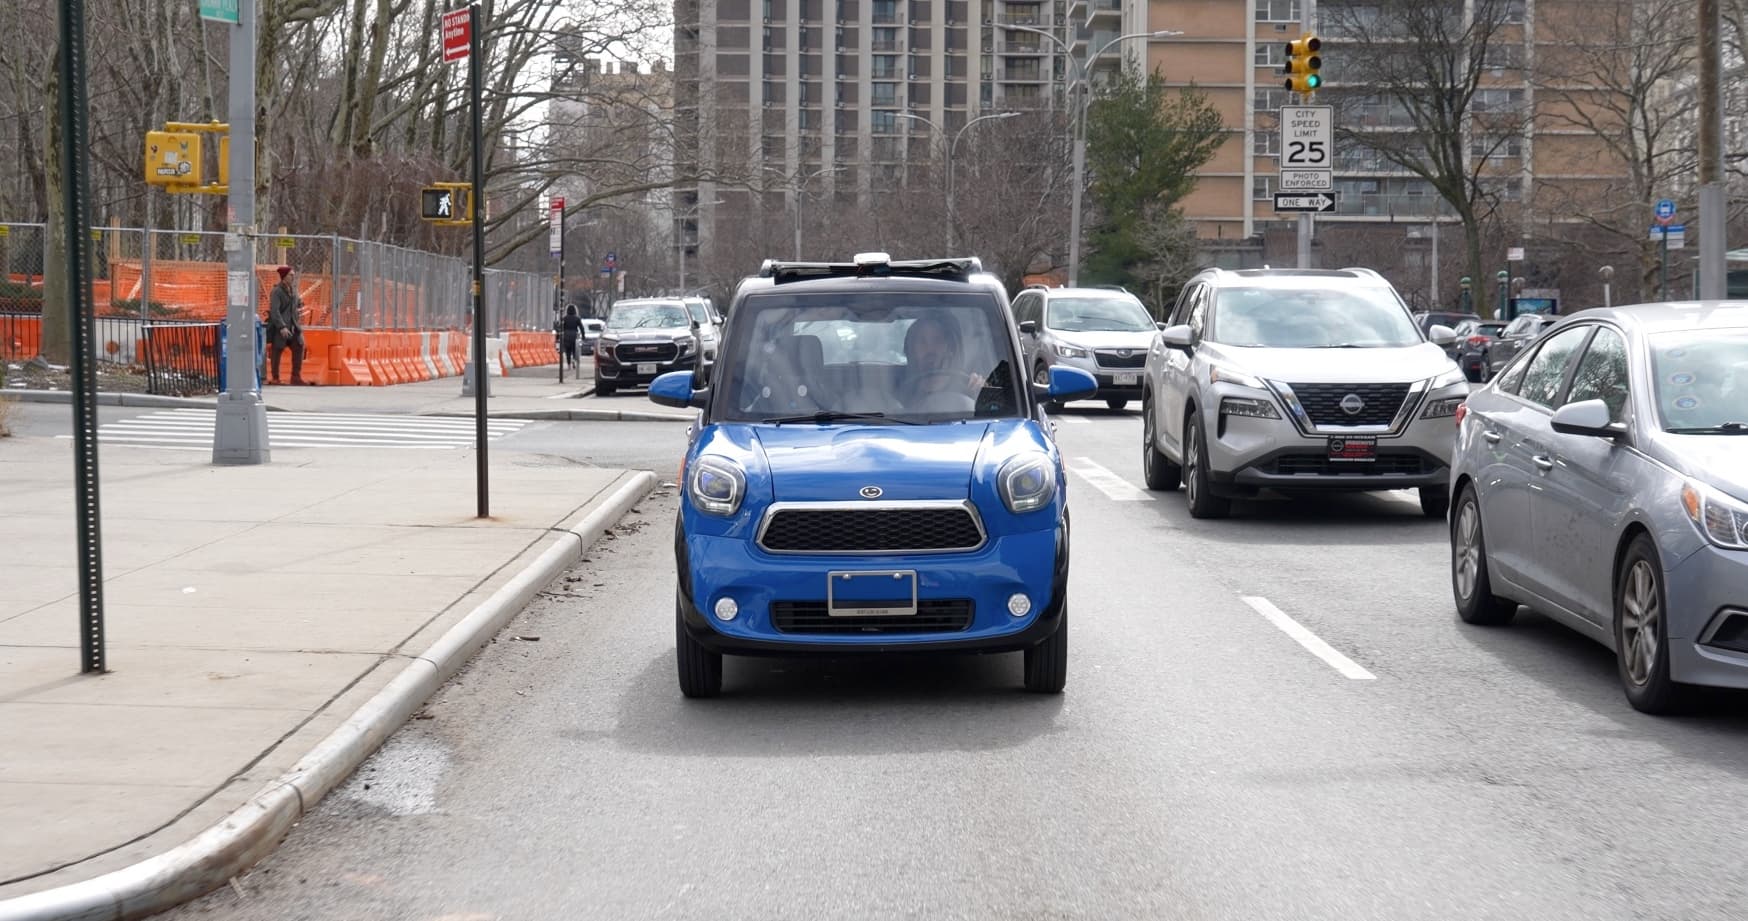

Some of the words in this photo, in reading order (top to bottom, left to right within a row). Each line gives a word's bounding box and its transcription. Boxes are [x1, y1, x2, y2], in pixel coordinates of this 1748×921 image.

[444, 18, 451, 28] NO
[1288, 141, 1325, 163] 25
[1282, 198, 1301, 206] ONE
[1308, 198, 1326, 206] WAY
